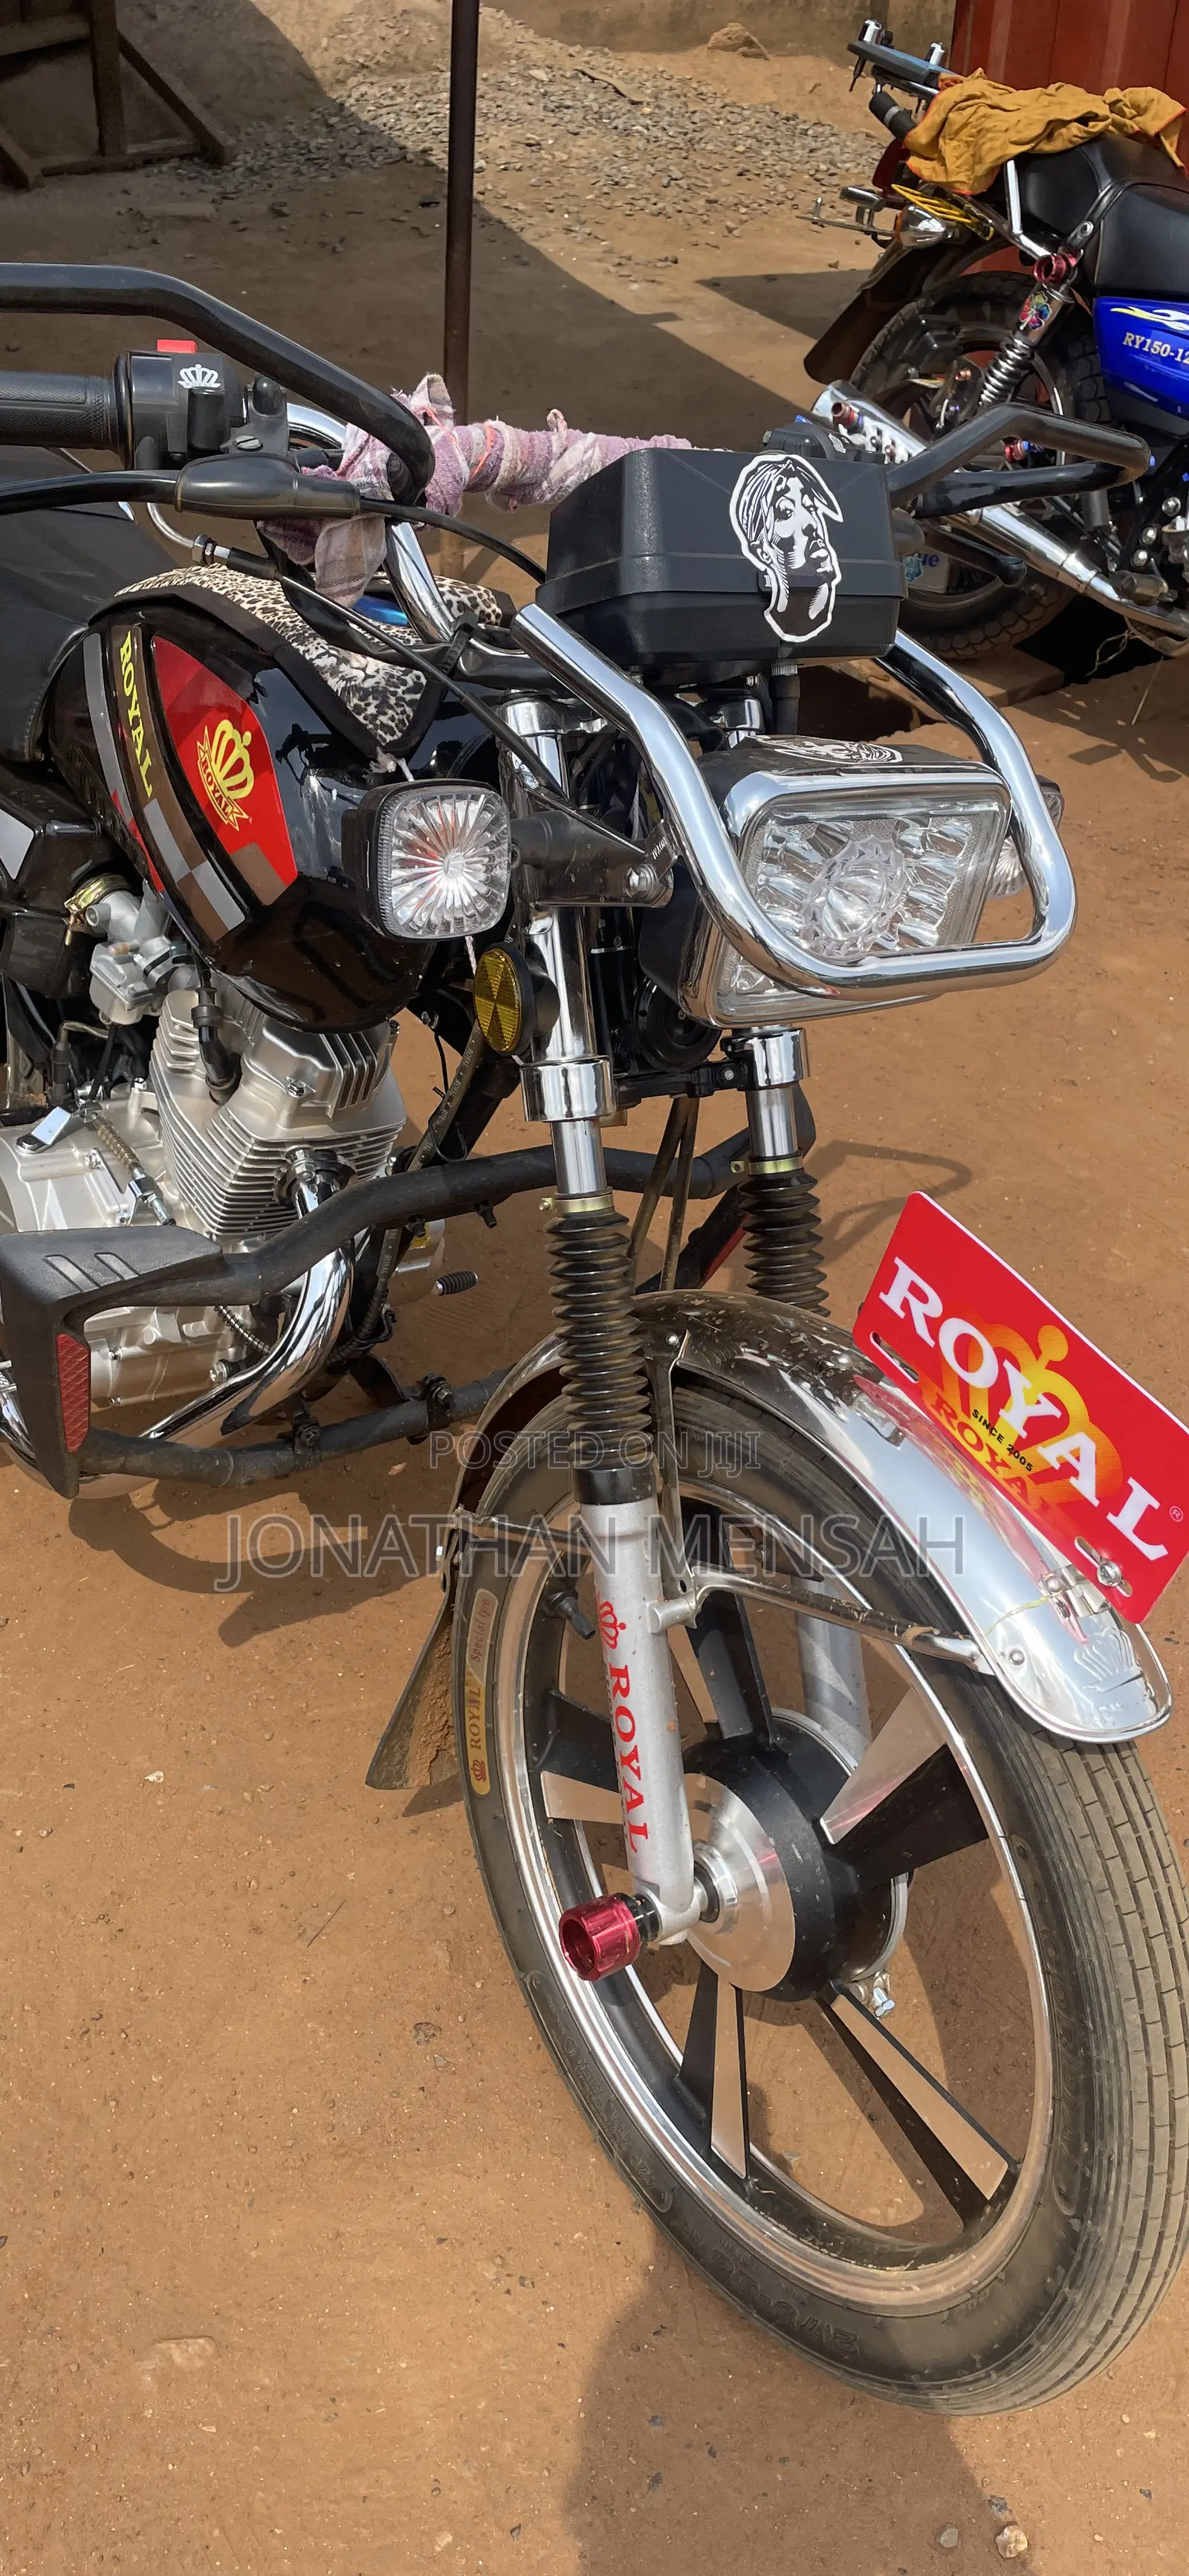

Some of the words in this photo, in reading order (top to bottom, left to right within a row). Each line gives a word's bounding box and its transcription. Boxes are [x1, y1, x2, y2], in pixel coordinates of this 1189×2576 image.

[120, 630, 152, 798] ROYAL
[200, 758, 231, 818] ROYAL
[450, 1079, 461, 1097] ROYAL
[878, 1256, 1170, 1561] ROYAL
[972, 1409, 1005, 1444] SINCE
[1006, 1444, 1033, 1472] 2005
[470, 1619, 485, 1662] Special
[468, 1687, 482, 1750] ROYAL
[609, 1662, 649, 1854] ROYAL
